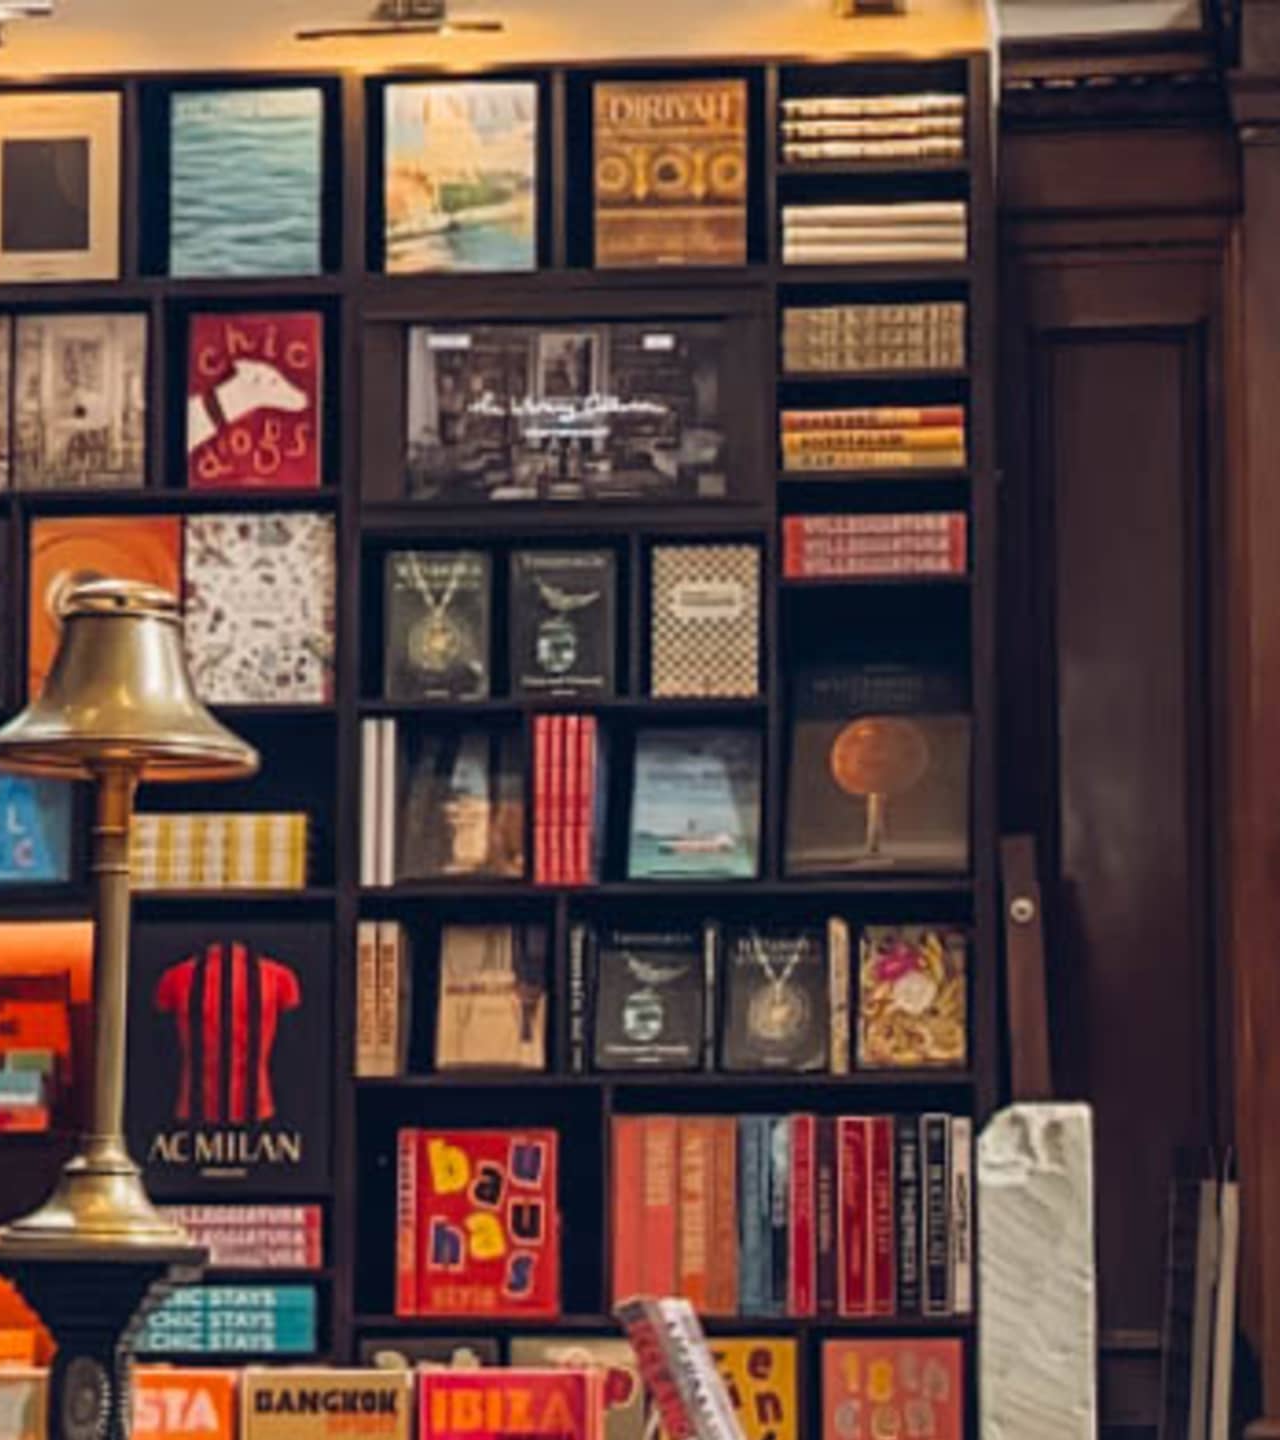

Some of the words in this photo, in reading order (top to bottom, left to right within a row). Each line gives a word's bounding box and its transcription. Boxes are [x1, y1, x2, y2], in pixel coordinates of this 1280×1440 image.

[197, 418, 312, 479] dogs
[150, 1131, 188, 1163] AC
[194, 1131, 303, 1163] MILAN
[148, 1311, 203, 1328] CHIC
[209, 1311, 277, 1328] STAYS
[148, 1332, 203, 1350] CHIC
[209, 1332, 277, 1350] STAYS
[133, 1388, 219, 1432] STA
[253, 1388, 398, 1415] BANGKOK
[432, 1388, 577, 1434] IBIZA
